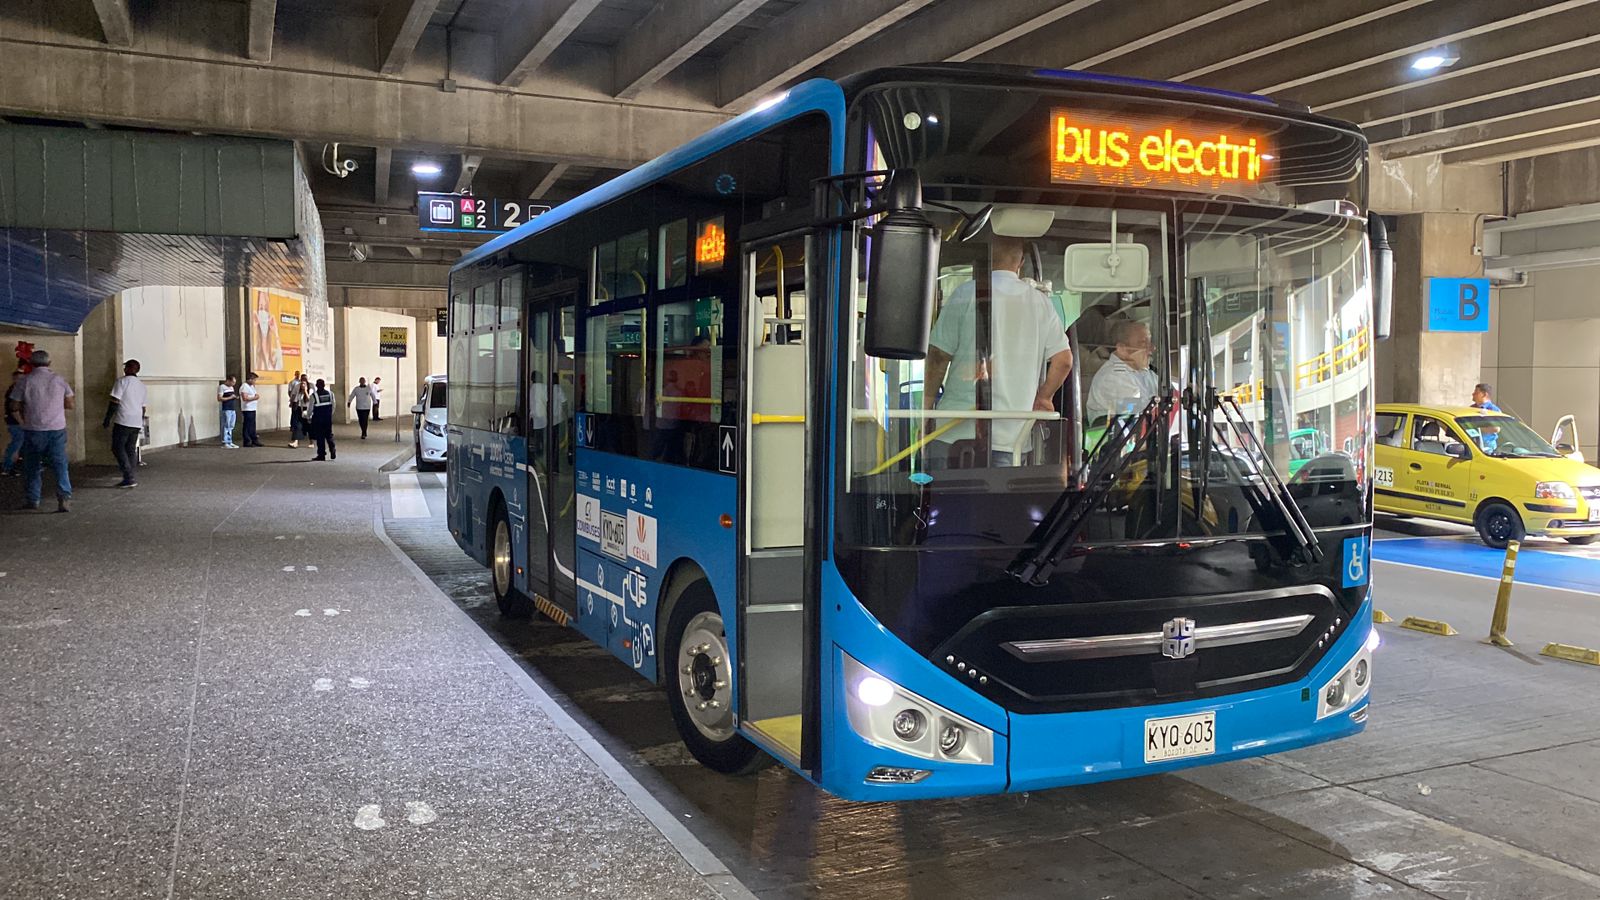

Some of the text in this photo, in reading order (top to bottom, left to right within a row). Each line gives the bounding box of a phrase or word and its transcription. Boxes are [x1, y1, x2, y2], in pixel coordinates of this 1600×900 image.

[1056, 117, 1130, 168] bus
[463, 200, 486, 213] A 2
[503, 202, 521, 228] 2
[464, 215, 486, 228] B 2
[1459, 284, 1480, 320] B
[390, 331, 406, 340] Taxi
[1148, 720, 1213, 750] KYQ 603
